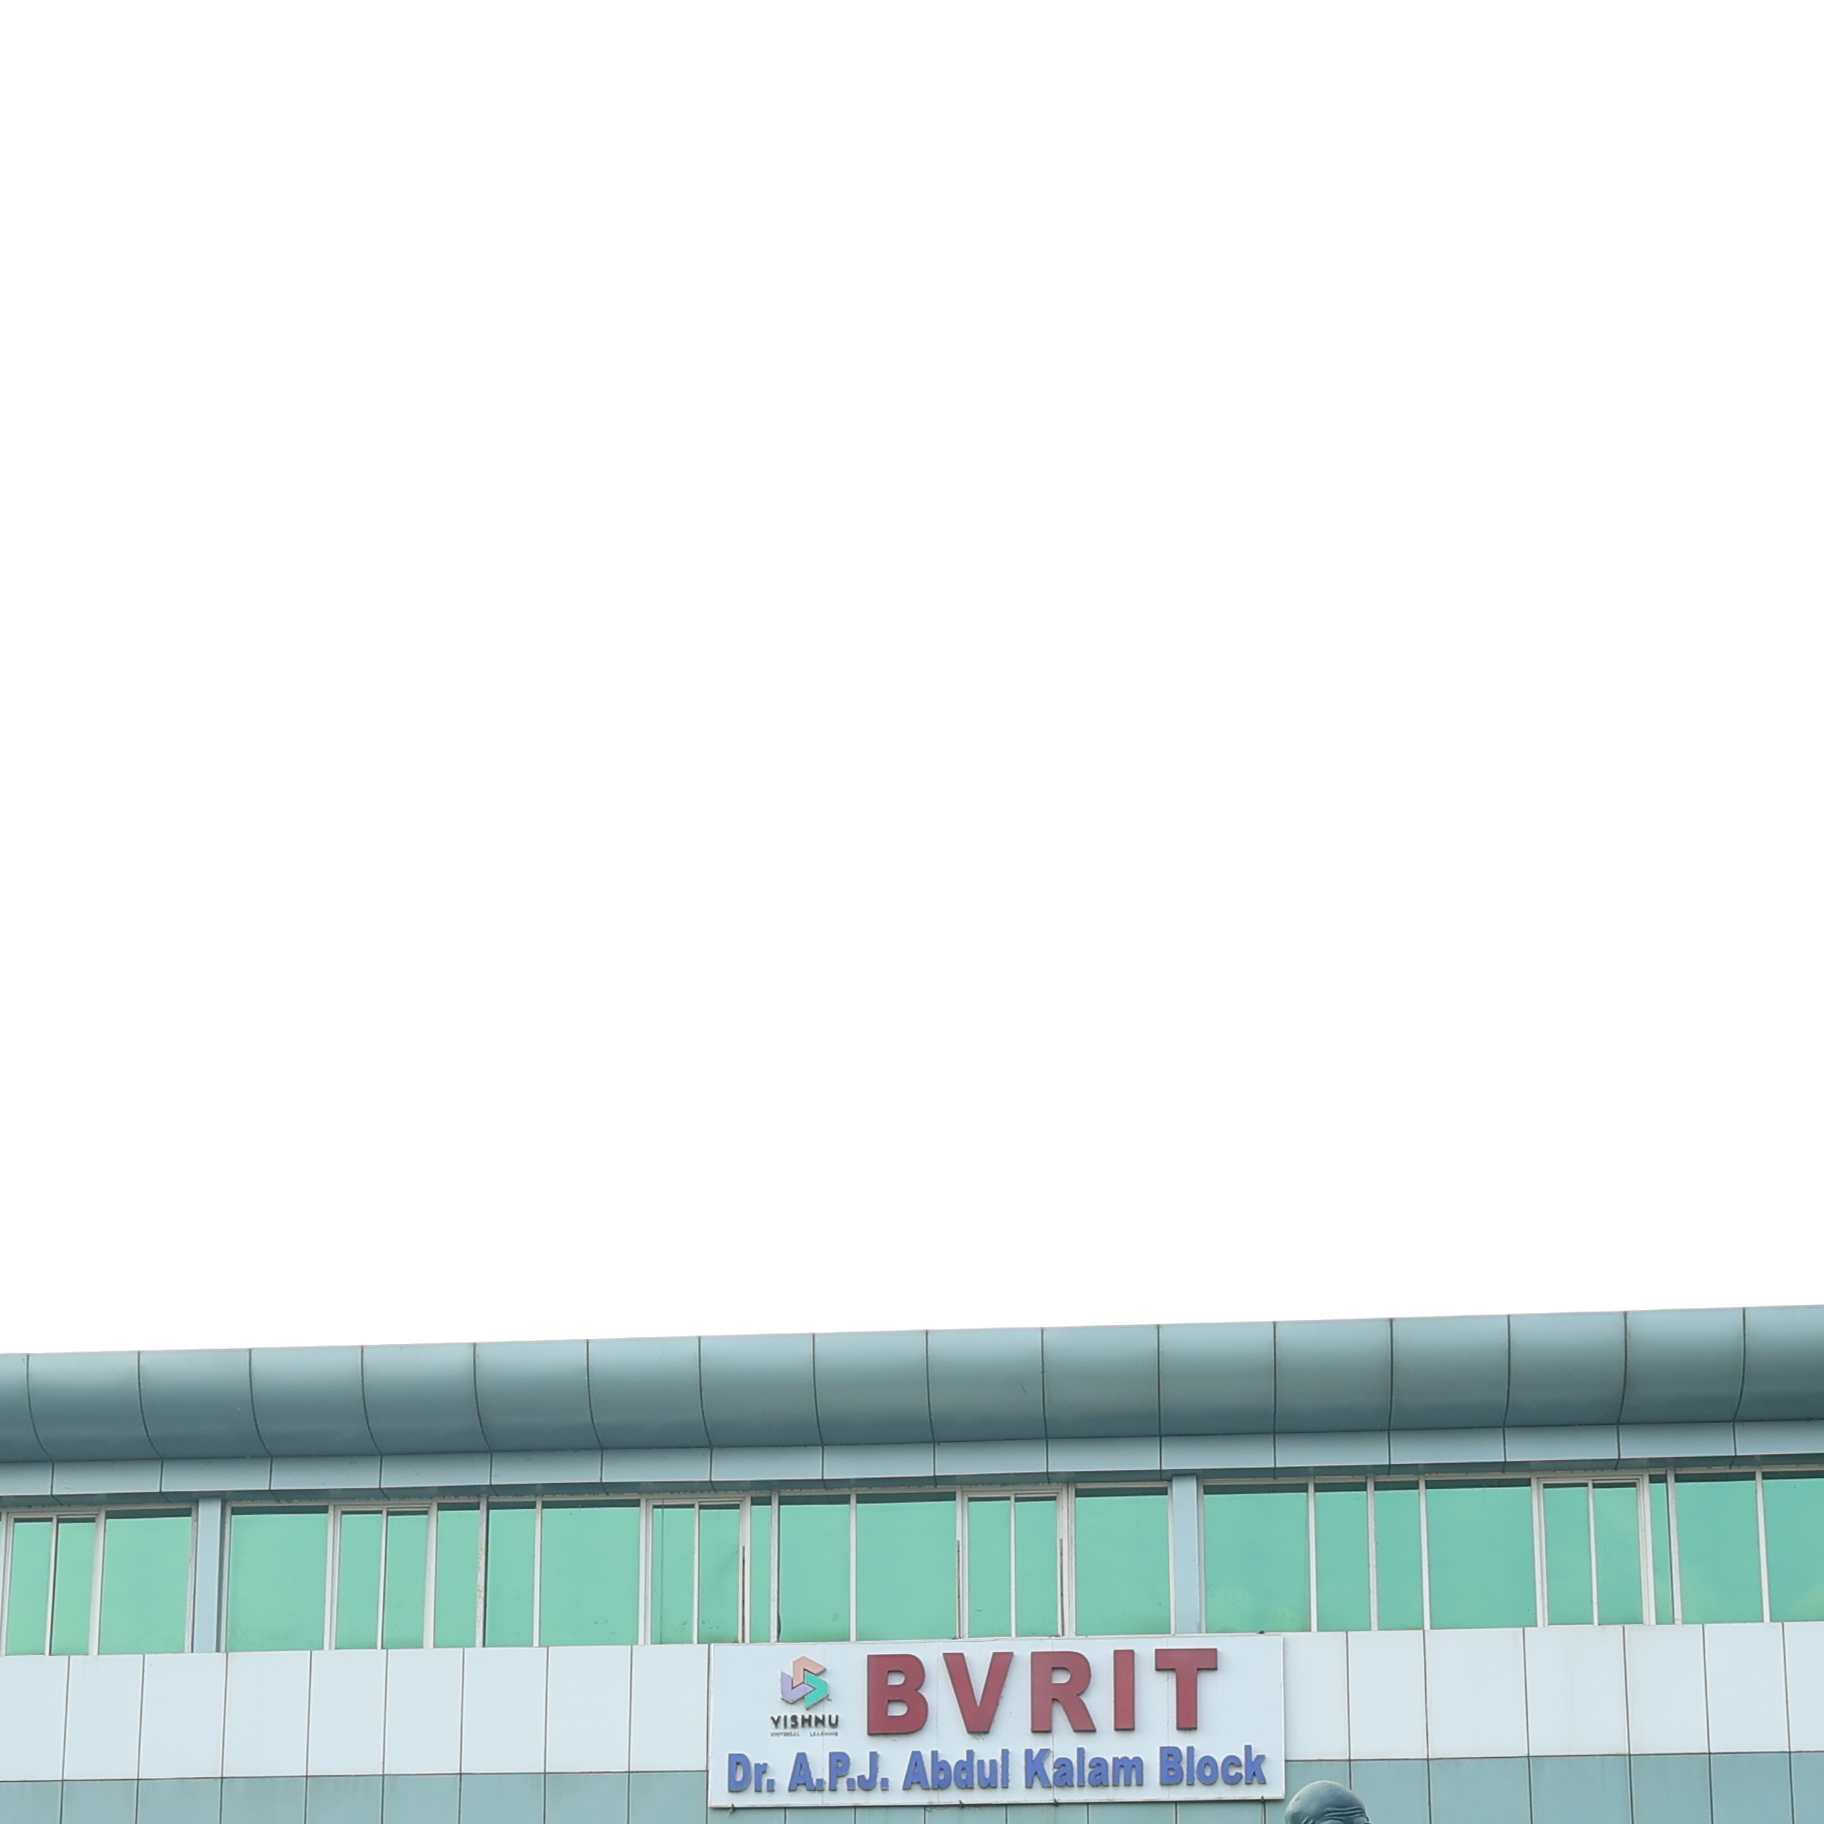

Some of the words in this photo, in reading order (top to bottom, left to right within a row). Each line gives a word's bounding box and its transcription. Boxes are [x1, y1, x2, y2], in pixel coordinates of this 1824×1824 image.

[866, 1648, 1218, 1735] BVRIT
[770, 1714, 839, 1729] VISHNU
[728, 1753, 775, 1792] Dr.
[788, 1751, 889, 1791] A.P.J.
[903, 1749, 1009, 1790] Abdul
[1024, 1747, 1143, 1788] Kalam
[1159, 1745, 1266, 1785] Block
